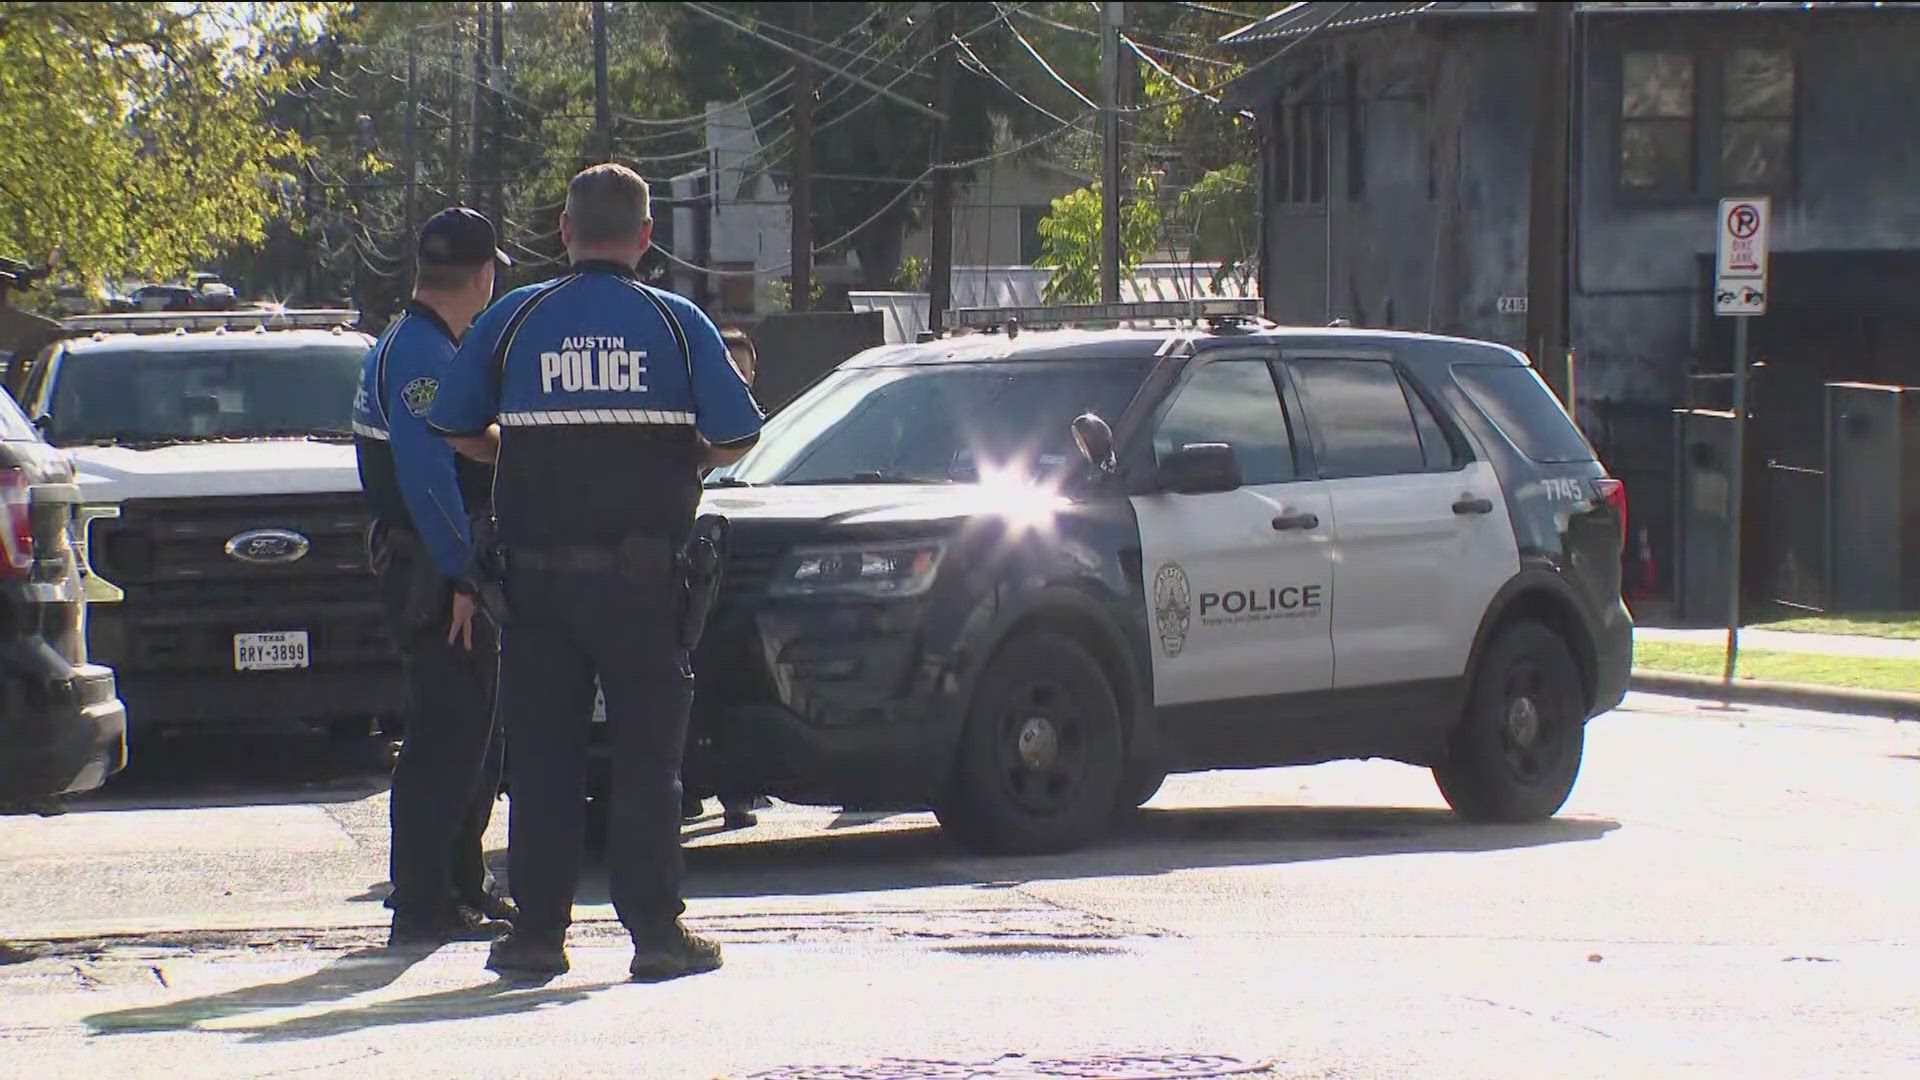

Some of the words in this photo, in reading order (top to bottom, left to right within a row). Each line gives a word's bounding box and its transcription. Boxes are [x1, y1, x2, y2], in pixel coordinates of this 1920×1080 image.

[561, 336, 625, 350] AUSTIN
[540, 350, 648, 393] POLICE
[1541, 479, 1583, 500] 7745
[1200, 585, 1322, 616] POLICE
